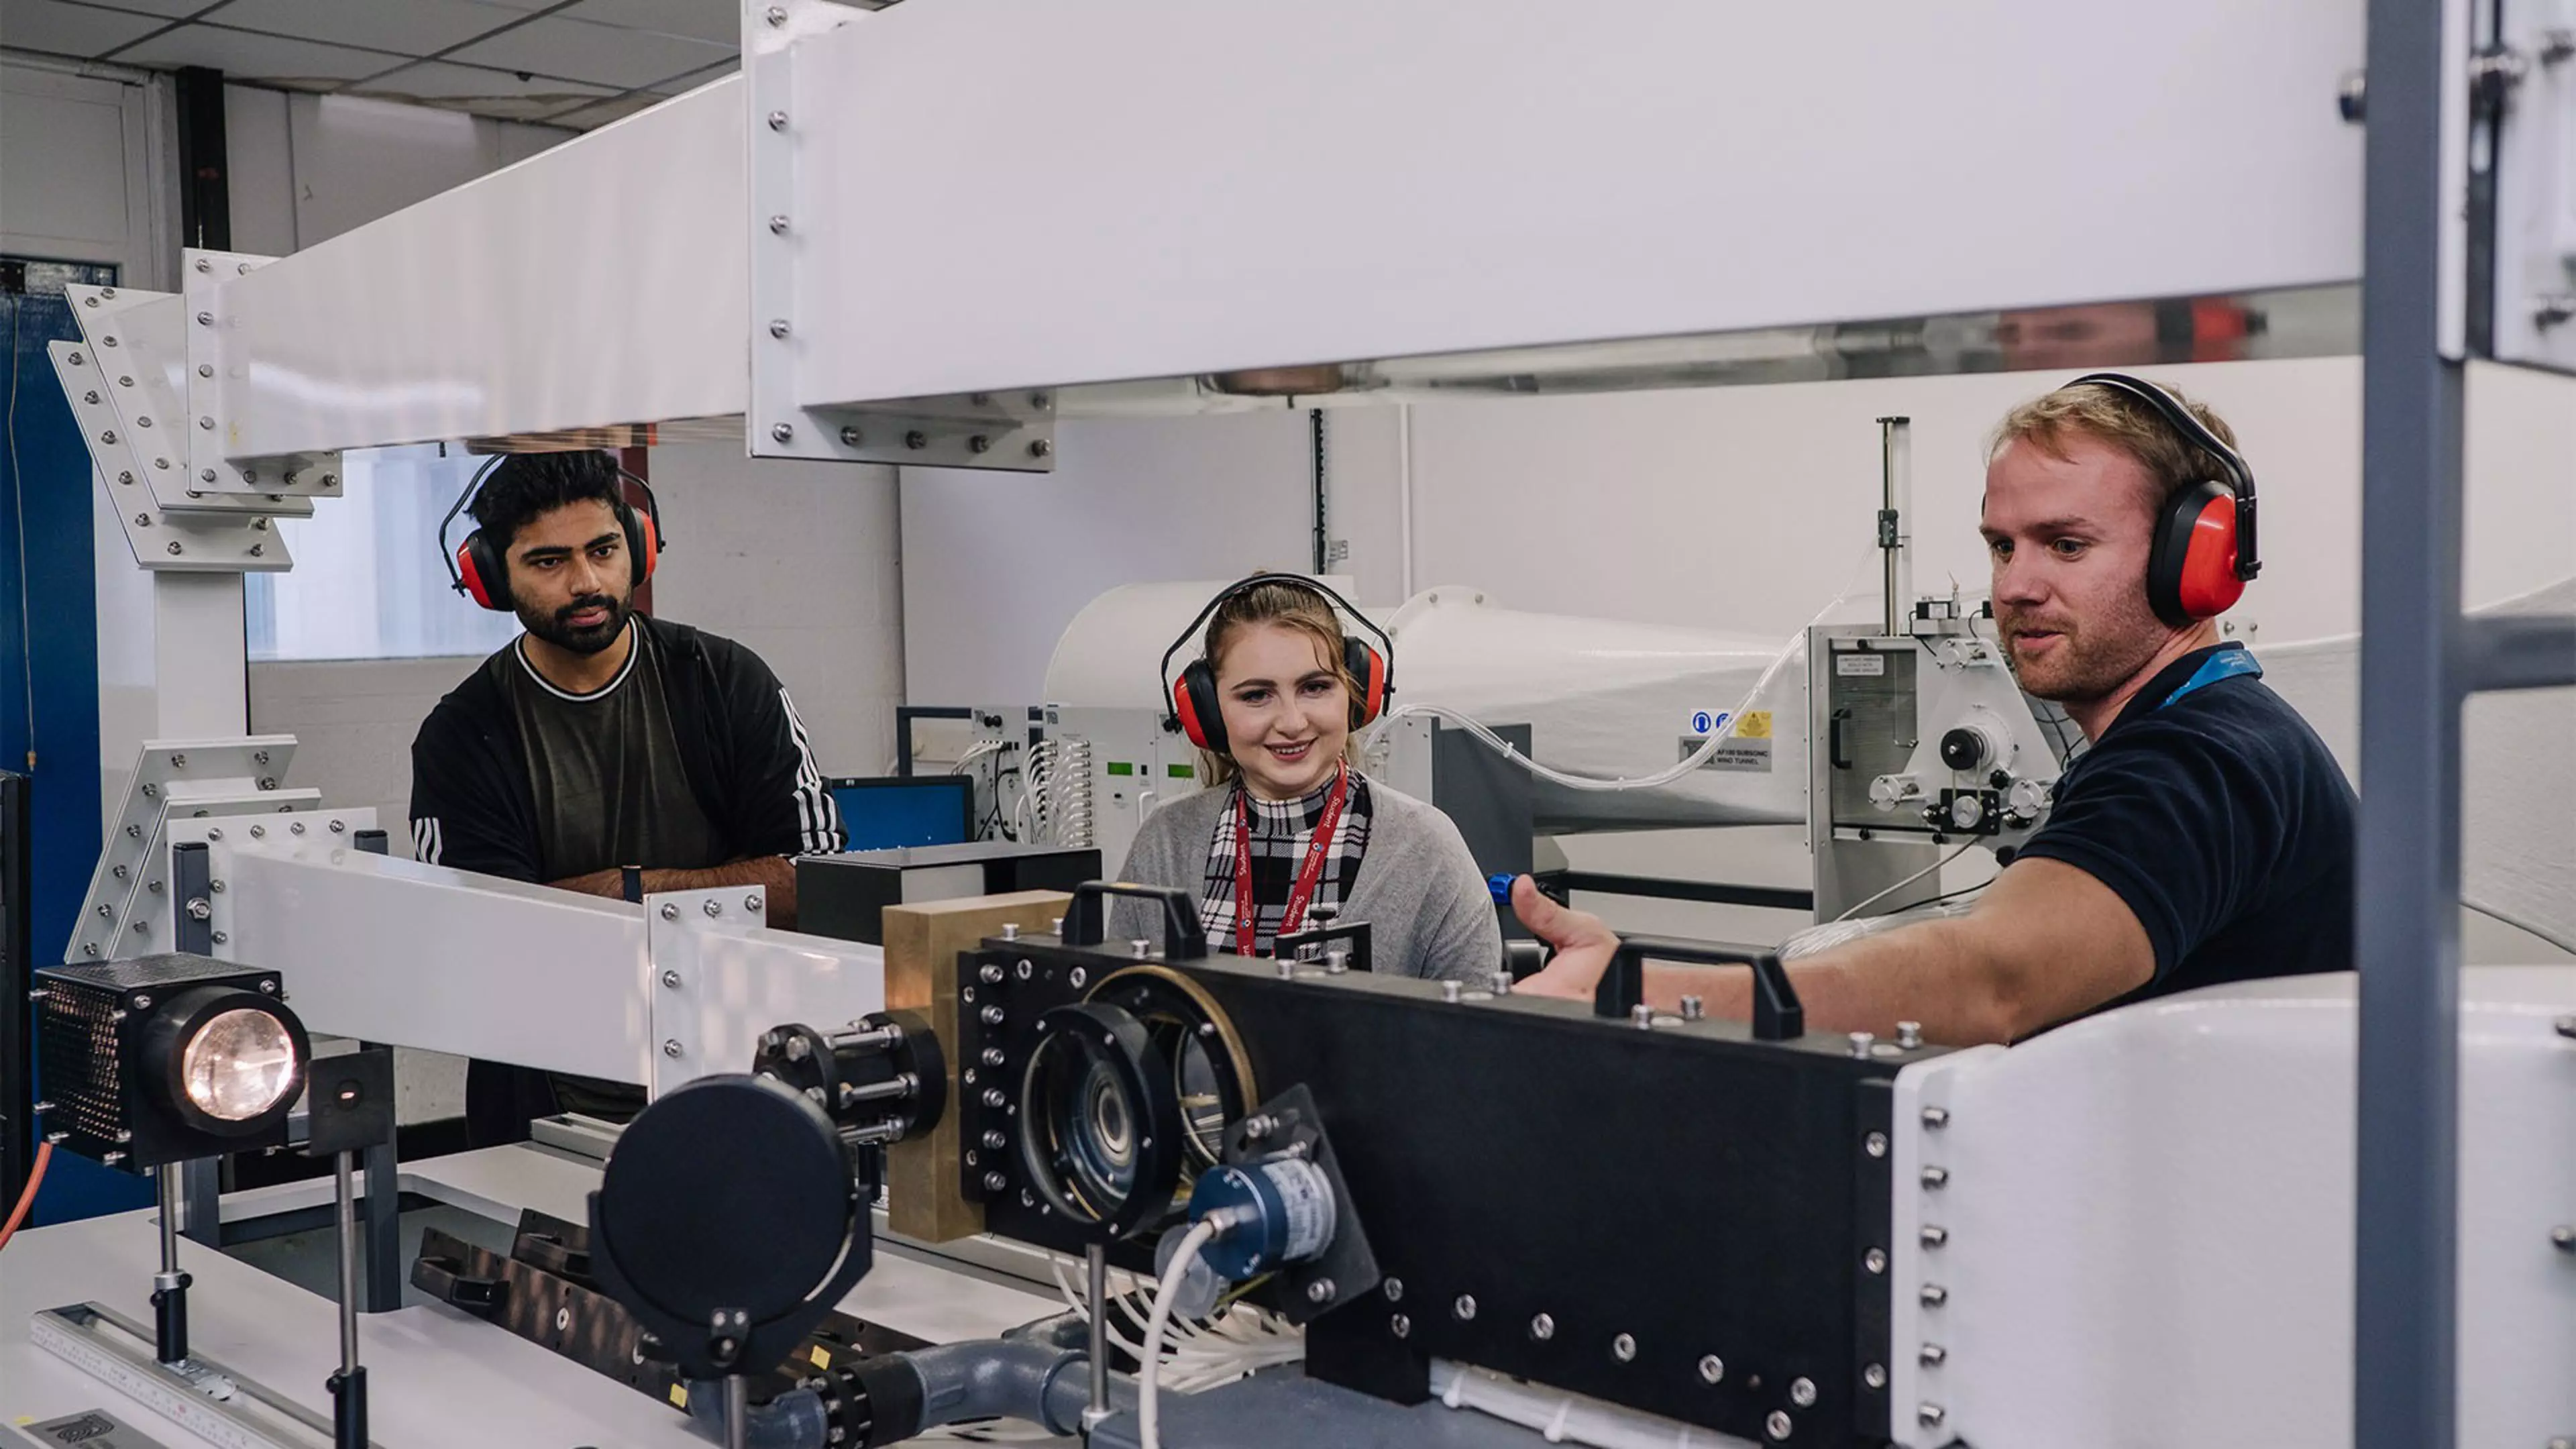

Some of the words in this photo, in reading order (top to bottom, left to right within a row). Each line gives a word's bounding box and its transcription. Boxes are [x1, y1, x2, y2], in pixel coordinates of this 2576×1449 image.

[1324, 796, 1341, 828] Student
[1239, 842, 1247, 876] Student
[1285, 894, 1305, 927] Student
